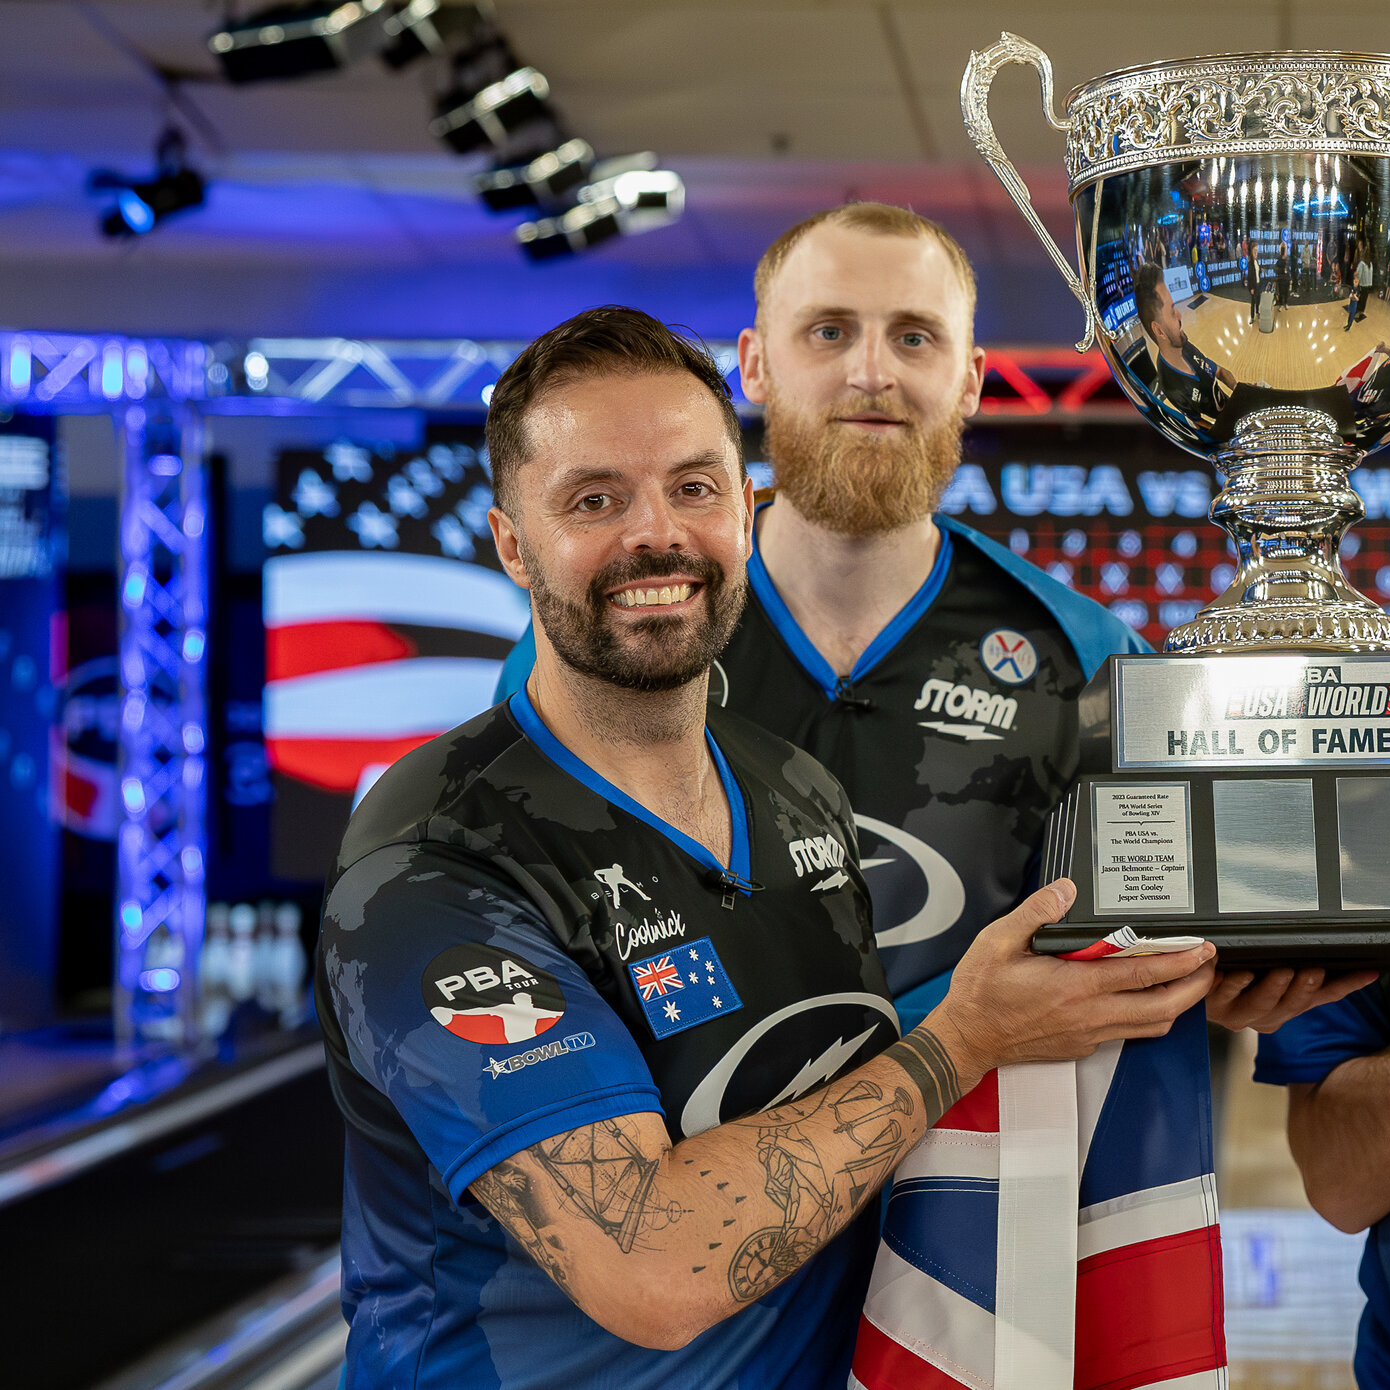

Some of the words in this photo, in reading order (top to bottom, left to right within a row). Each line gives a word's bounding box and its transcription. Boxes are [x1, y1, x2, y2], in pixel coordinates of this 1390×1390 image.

[1001, 463, 1134, 516] USA
[913, 678, 1018, 730] STORM
[1307, 686, 1389, 716] WORLD
[1167, 729, 1244, 756] HALL
[1257, 728, 1297, 756] OF
[789, 833, 845, 877] STORM
[1101, 865, 1120, 874] Jason
[1161, 864, 1185, 873] Captain
[1118, 894, 1138, 902] Jesper
[1141, 884, 1164, 892] Cooley
[615, 908, 686, 961] Coolwick
[434, 959, 534, 1002] PBA
[505, 978, 540, 991] TOUR
